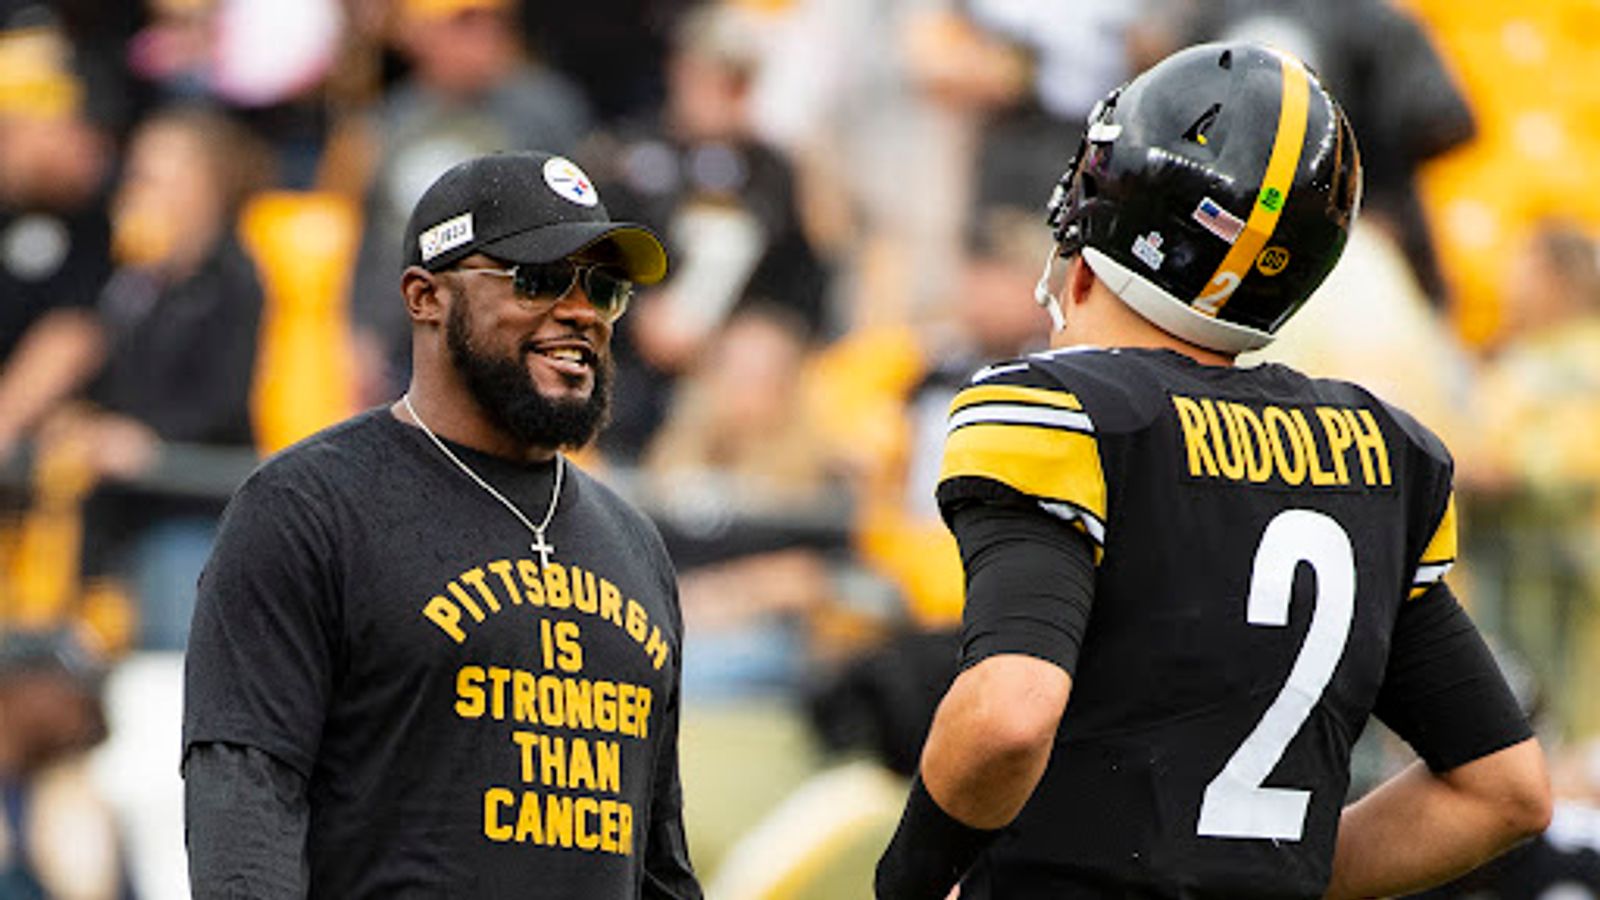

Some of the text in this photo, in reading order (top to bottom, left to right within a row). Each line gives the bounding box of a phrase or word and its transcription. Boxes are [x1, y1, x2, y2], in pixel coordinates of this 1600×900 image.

[1192, 271, 1241, 311] 2
[1172, 396, 1392, 485] RUDOLPH
[422, 559, 669, 670] PITTSBURGH
[541, 618, 583, 672] IS
[455, 666, 652, 739] STRONGER
[1197, 509, 1355, 841] 2
[512, 731, 620, 793] THAN
[484, 788, 633, 856] CANCER
